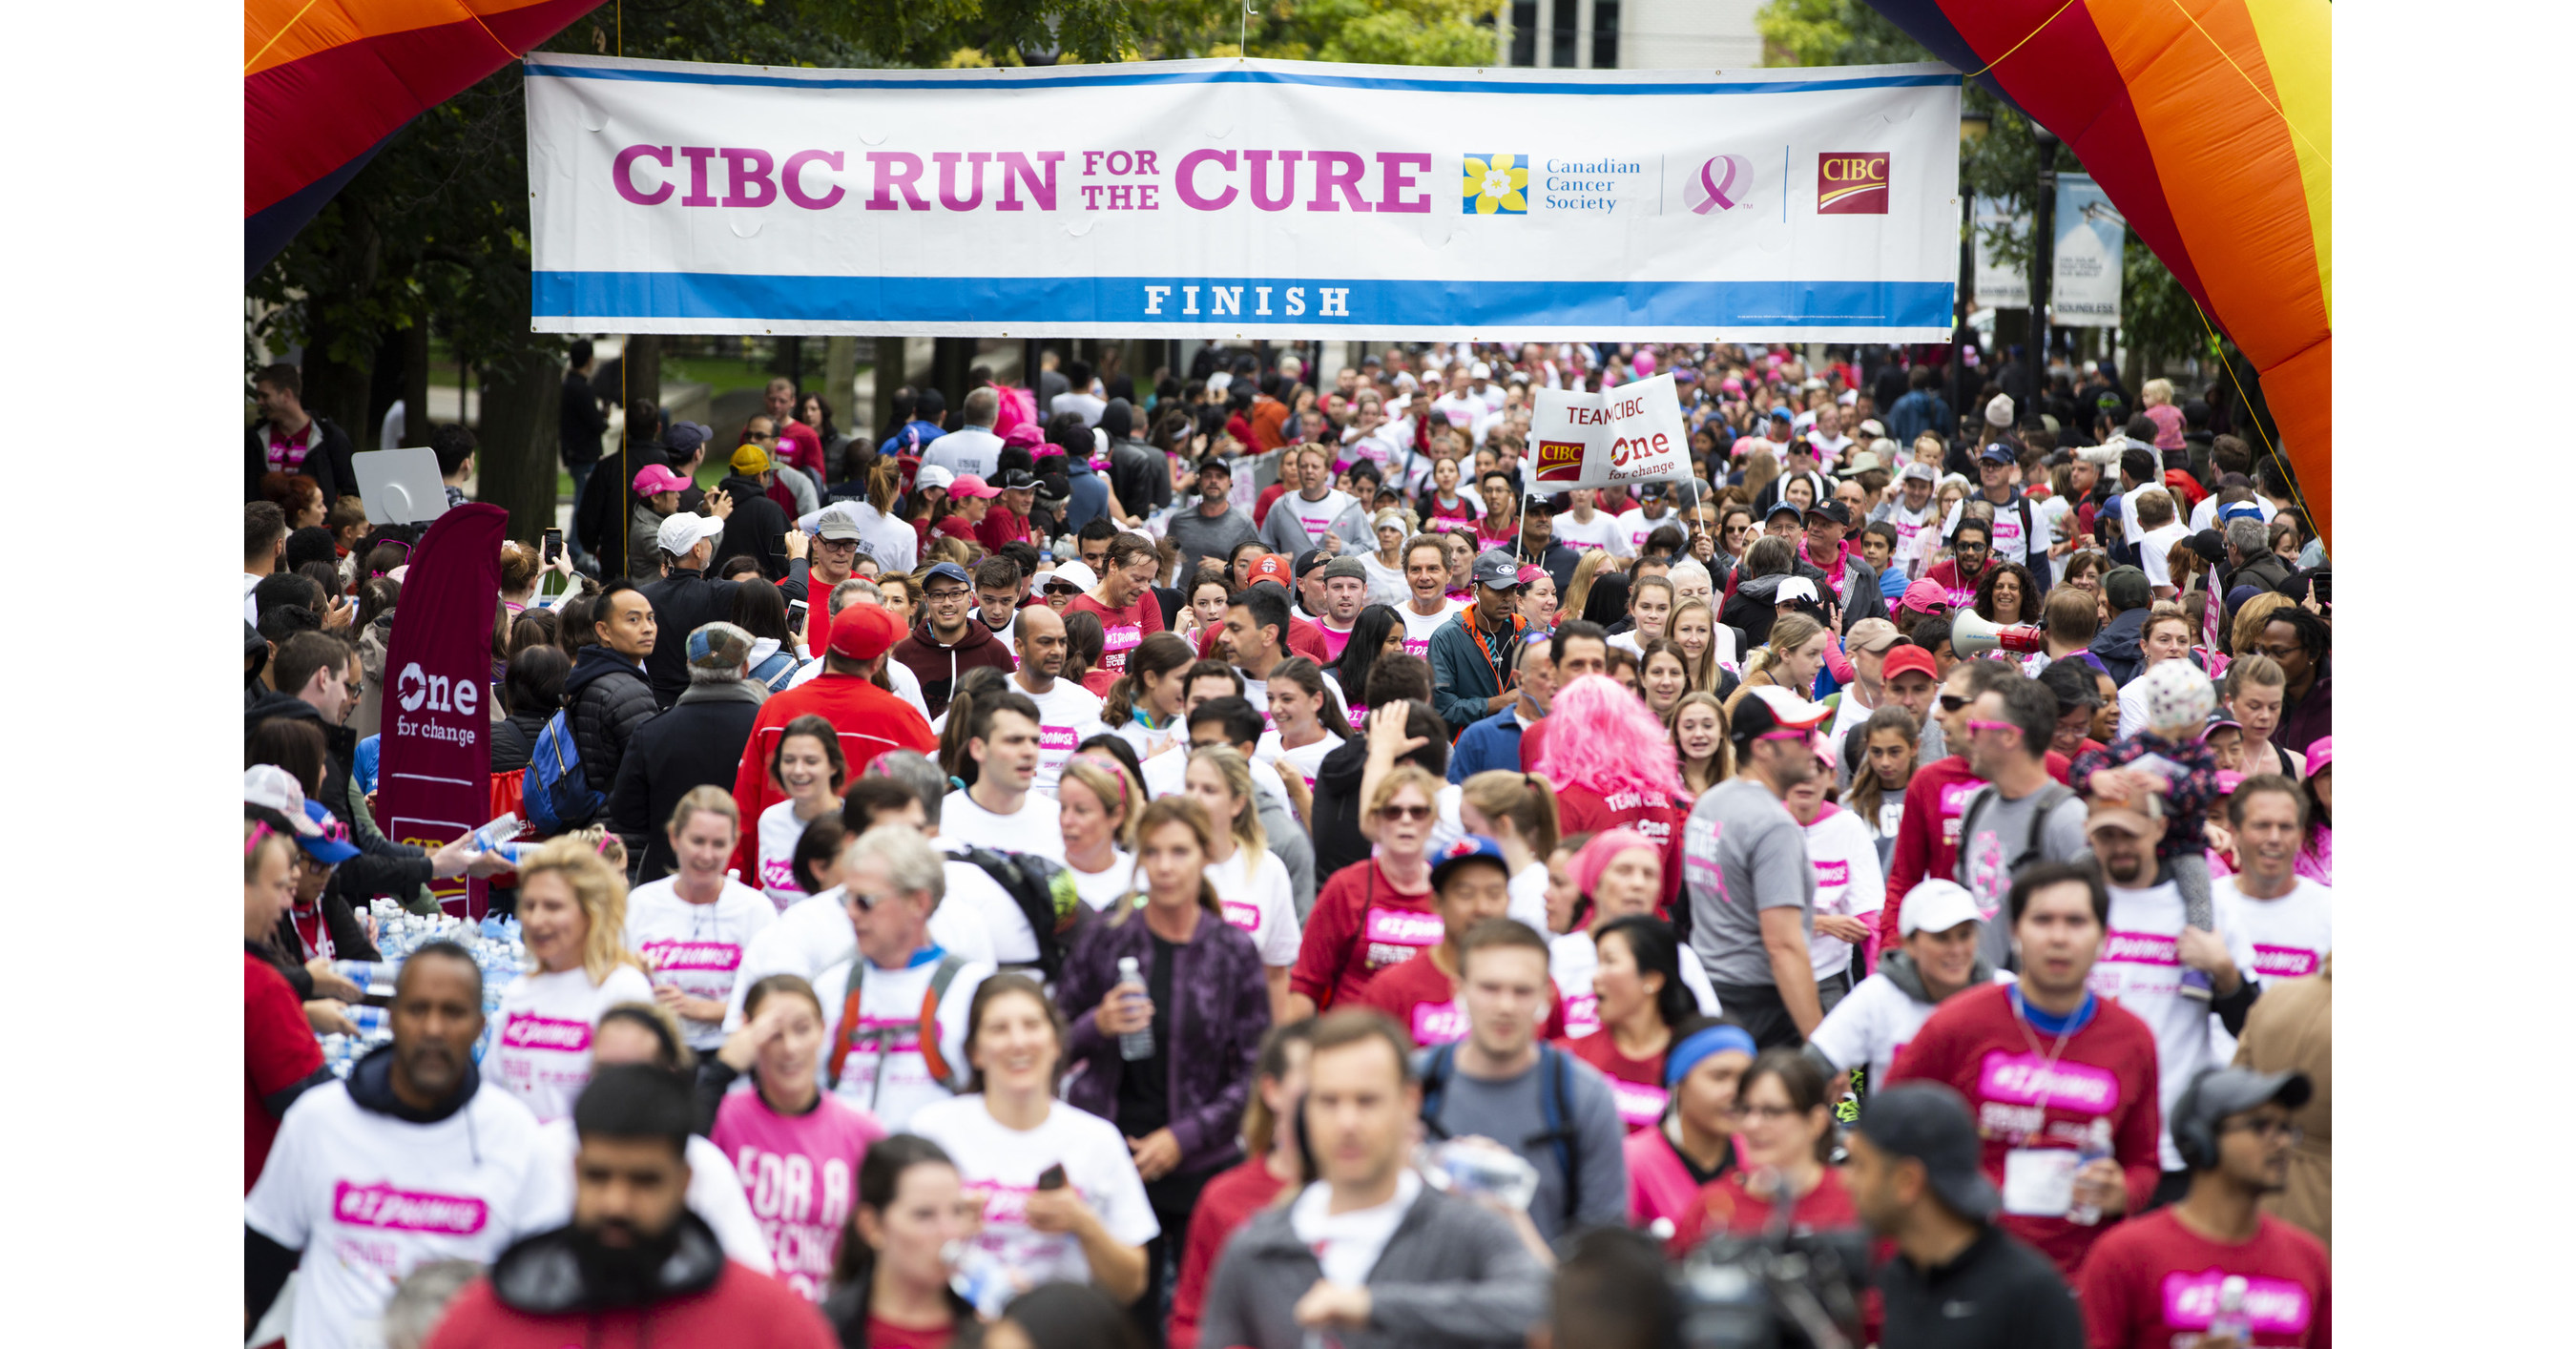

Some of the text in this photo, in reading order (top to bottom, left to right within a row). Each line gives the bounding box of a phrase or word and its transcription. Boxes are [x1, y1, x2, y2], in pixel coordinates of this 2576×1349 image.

[1081, 149, 1160, 176] FOR
[1547, 157, 1641, 174] Canadian
[1822, 157, 1885, 183] CIBC
[612, 144, 1066, 212] CIBC RUN
[1174, 148, 1432, 214] CURE
[1546, 176, 1615, 192] Cancer
[1080, 184, 1160, 212] THE
[1545, 194, 1617, 214] Society
[1144, 285, 1350, 317] FINISH
[1567, 397, 1645, 425] TEAM CIBC
[1541, 444, 1583, 462] CIBC
[1610, 432, 1670, 467] One
[1608, 461, 1674, 480] for change
[397, 661, 478, 716] One
[397, 715, 475, 747] for change
